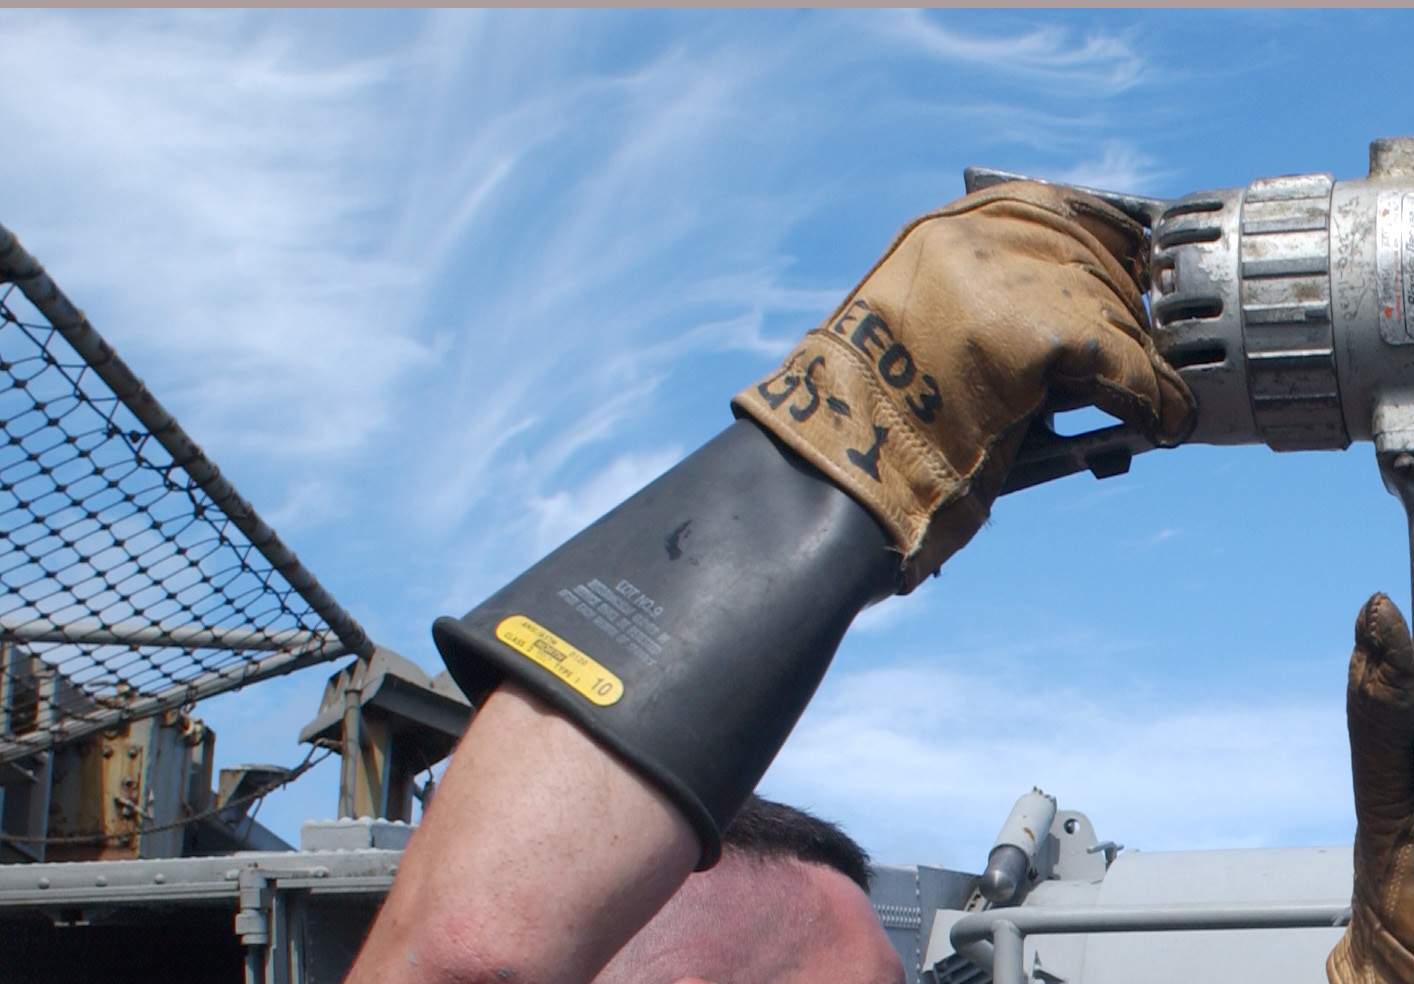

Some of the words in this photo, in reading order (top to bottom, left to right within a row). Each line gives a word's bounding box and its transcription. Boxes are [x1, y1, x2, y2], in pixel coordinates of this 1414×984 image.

[616, 580, 641, 602] LOT
[504, 631, 526, 648] CLASS
[591, 678, 613, 697] 10
